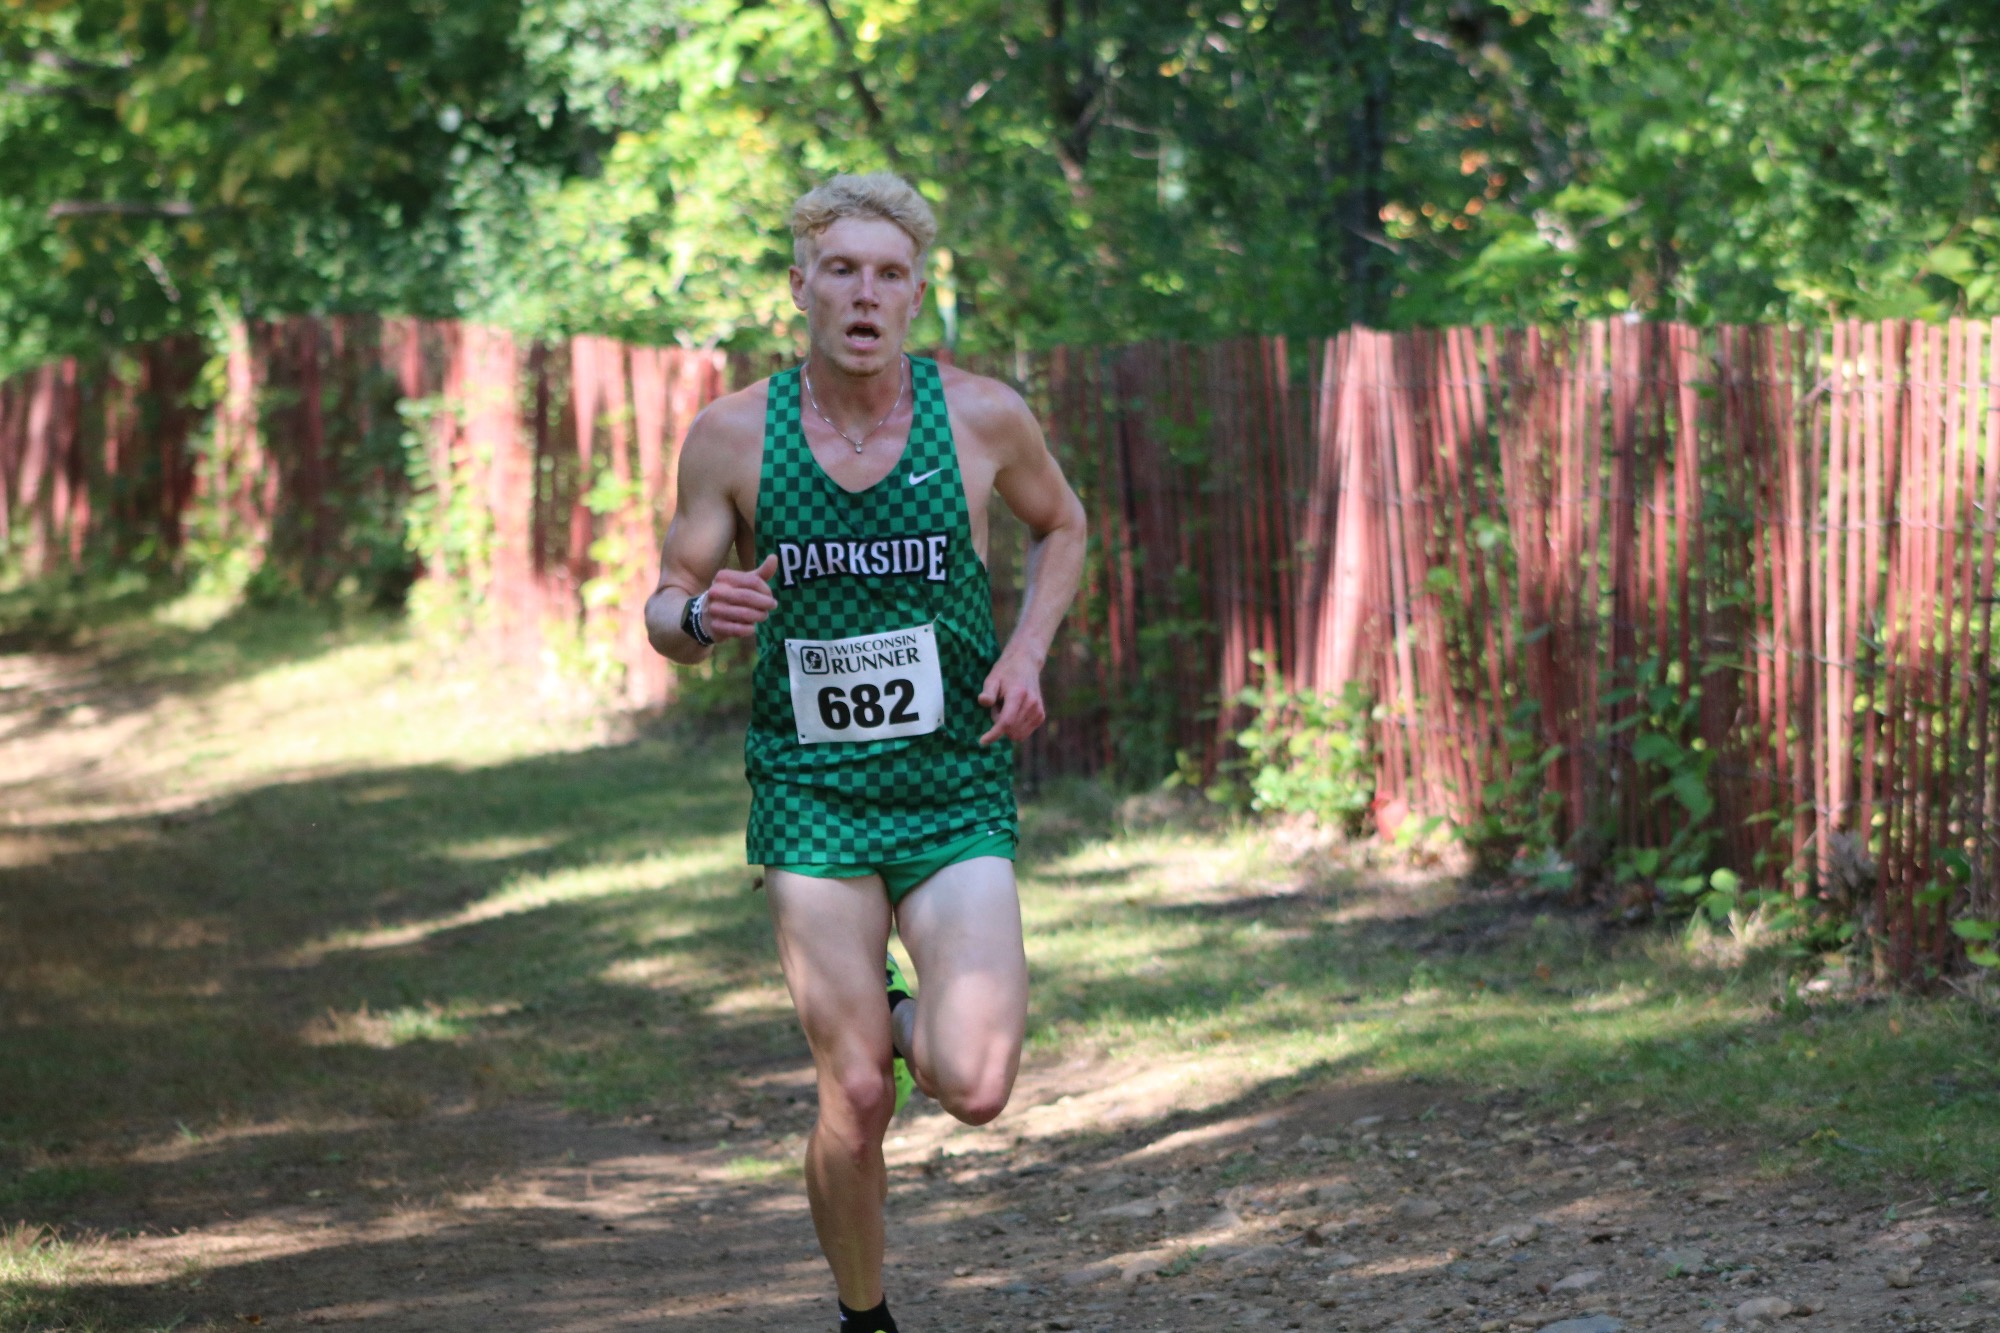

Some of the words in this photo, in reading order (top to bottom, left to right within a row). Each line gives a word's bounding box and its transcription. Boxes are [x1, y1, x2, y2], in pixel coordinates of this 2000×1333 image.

[779, 535, 947, 586] PARKSIDE
[831, 647, 921, 674] RUNNER
[834, 633, 917, 656] WISCONSIN
[818, 678, 920, 730] 682
